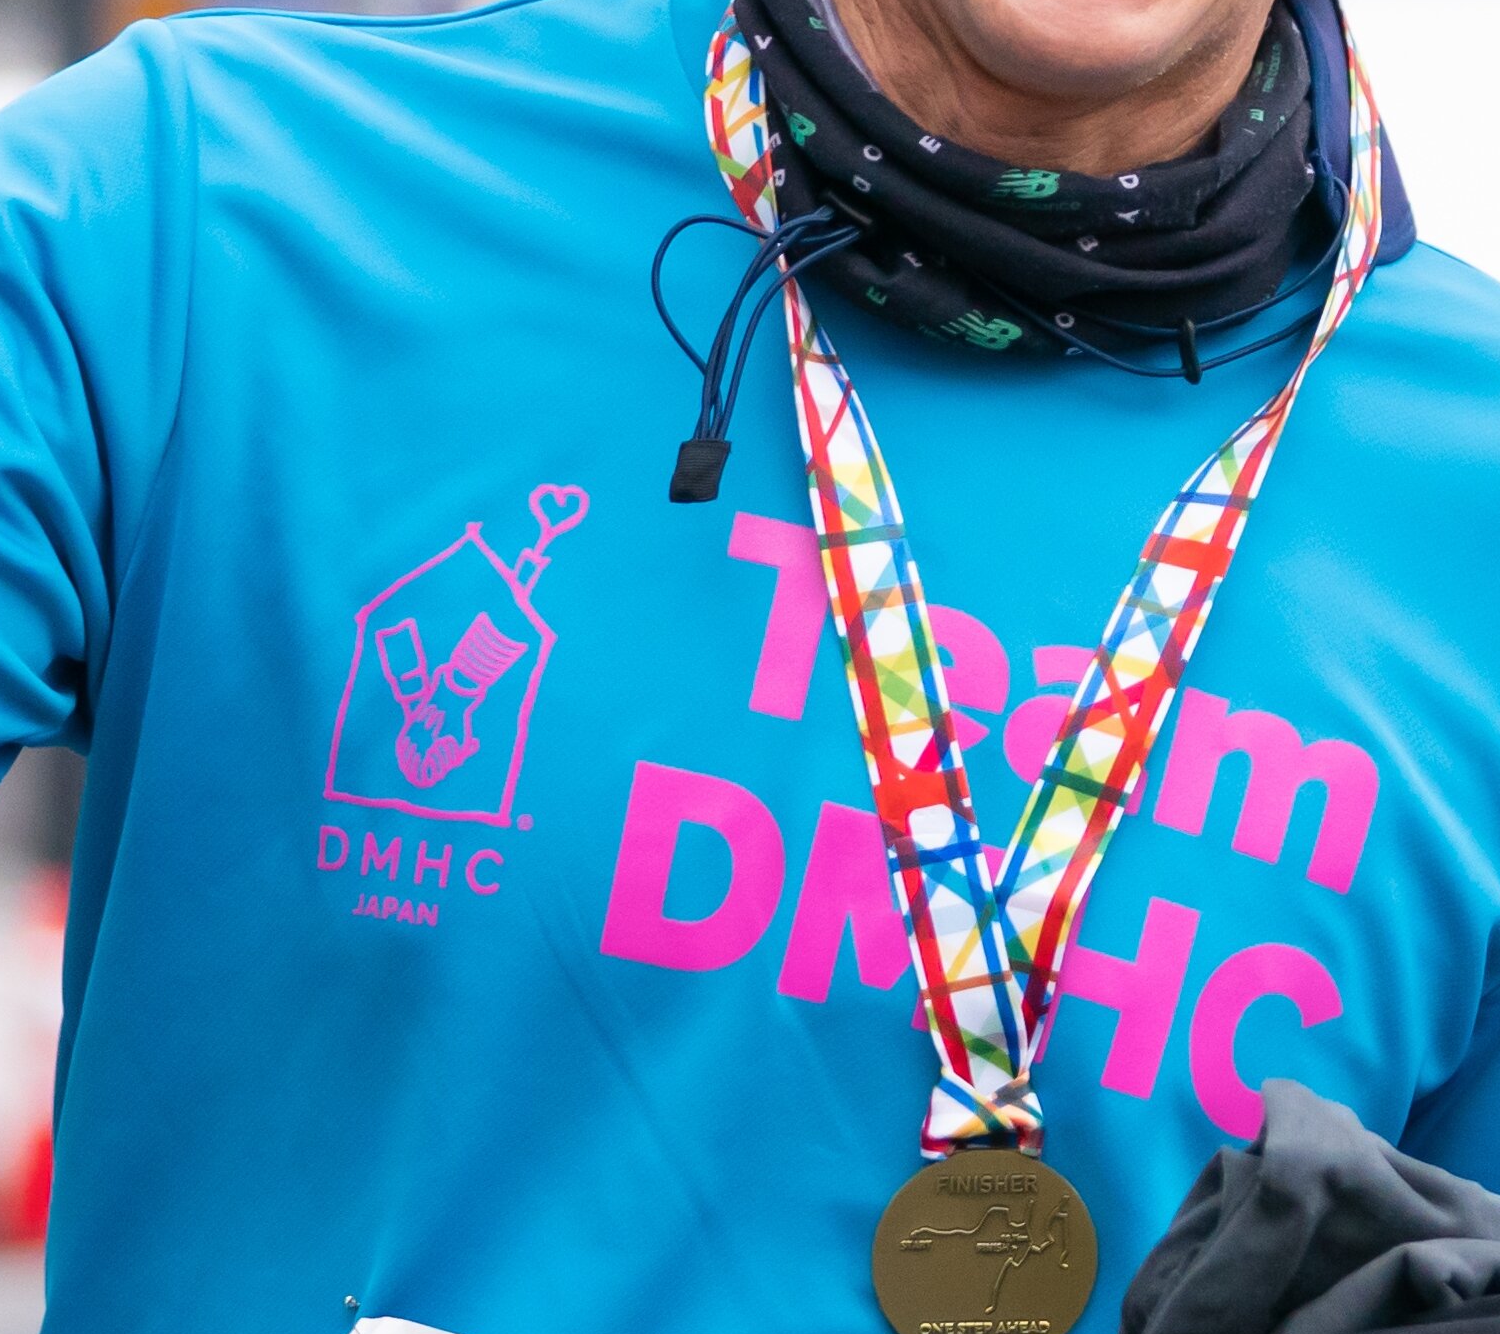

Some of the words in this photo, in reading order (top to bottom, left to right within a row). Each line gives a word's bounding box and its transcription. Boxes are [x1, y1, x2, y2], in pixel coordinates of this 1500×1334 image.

[315, 825, 506, 897] DMHC
[351, 892, 440, 928] JAPAN
[936, 1174, 1038, 1194] FINISHER
[997, 1320, 1051, 1334] AHEAD
